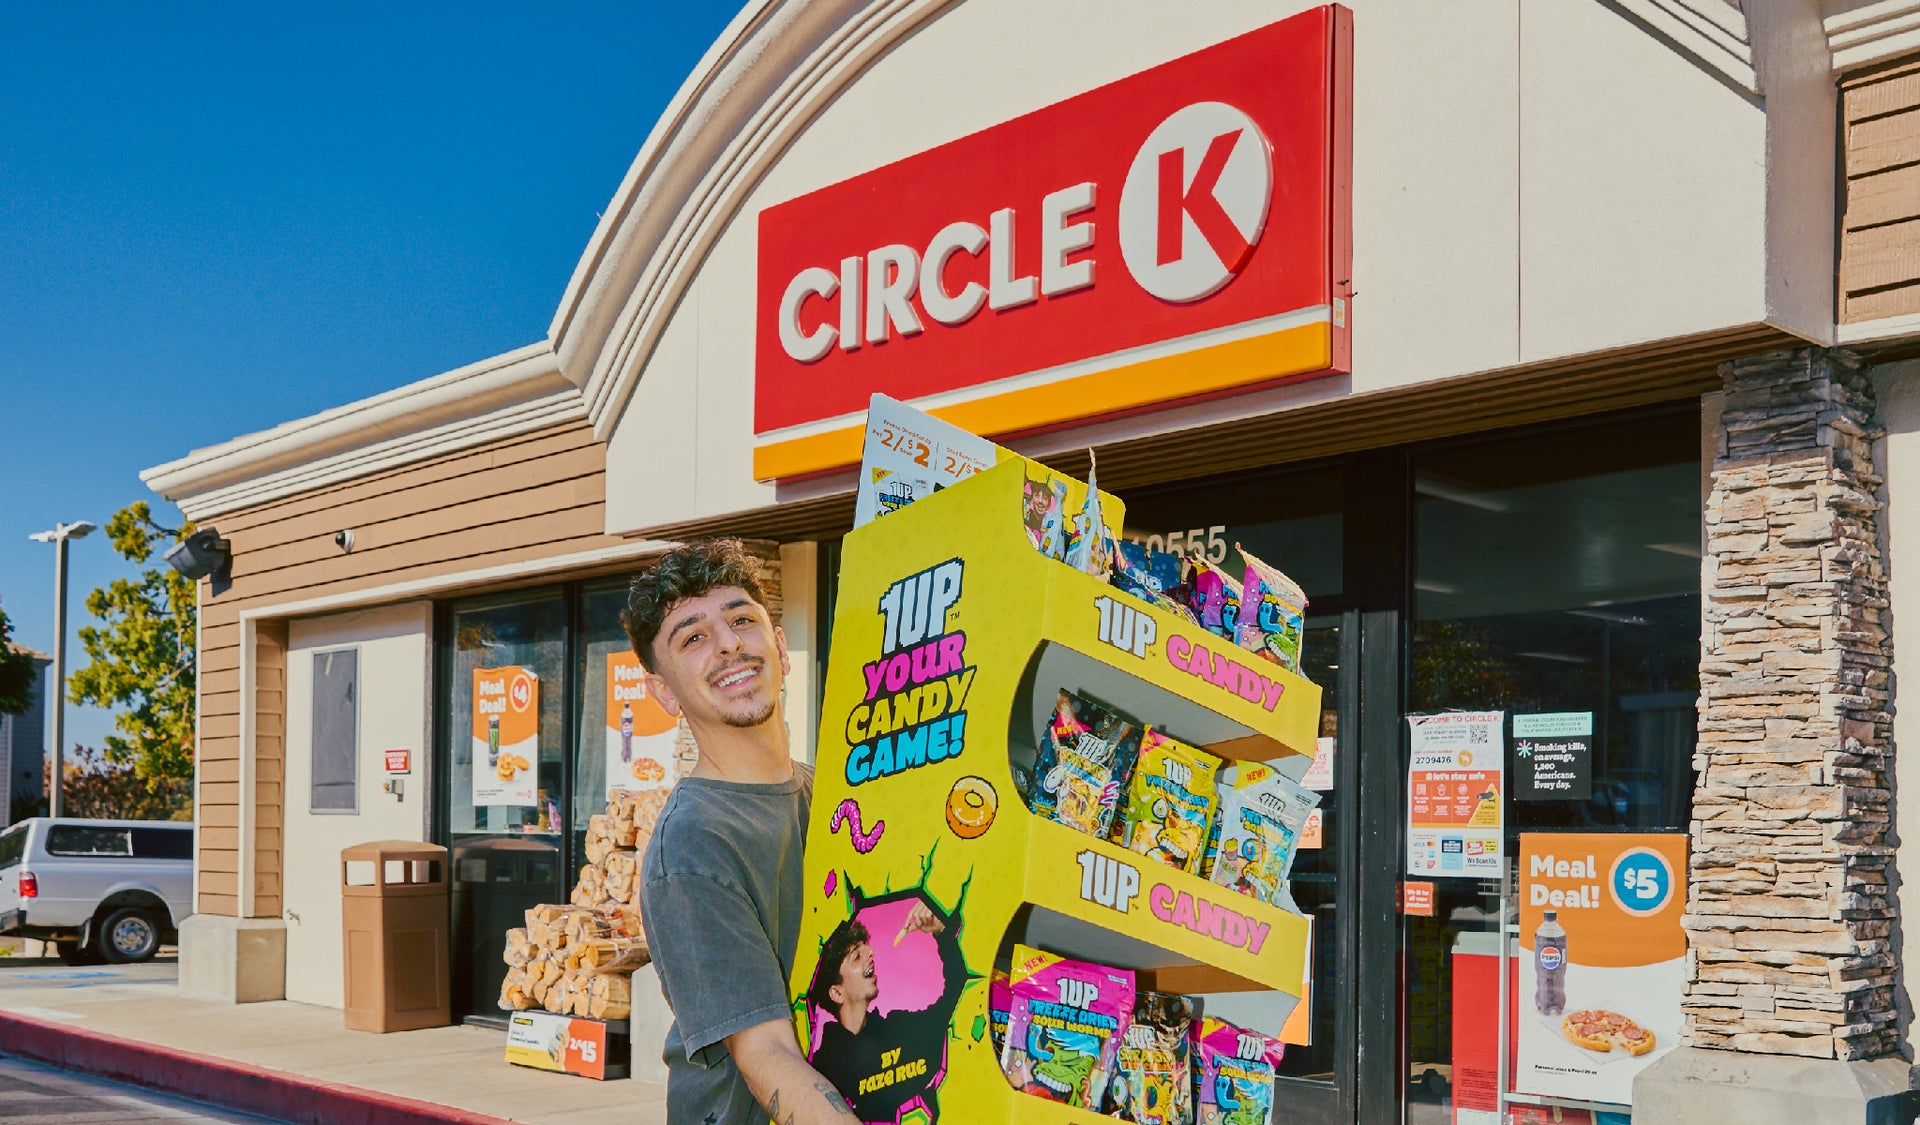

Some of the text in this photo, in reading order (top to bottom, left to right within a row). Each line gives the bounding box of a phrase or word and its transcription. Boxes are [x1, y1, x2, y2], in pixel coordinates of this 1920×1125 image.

[778, 128, 1254, 363] CIRCLE K
[1131, 525, 1227, 565] 0555
[879, 557, 964, 655] 1UP
[1095, 594, 1157, 660] 1UP
[1166, 634, 1284, 712] CANDY
[614, 664, 644, 682] Meal
[864, 632, 966, 701] YOUR
[479, 678, 505, 696] Meal
[513, 685, 528, 703] $4
[614, 683, 647, 701] Deal!
[479, 697, 507, 714] Deal!
[846, 665, 977, 745] CANDY
[1453, 715, 1463, 723] TO
[1465, 714, 1492, 722] CIRCLE
[846, 712, 967, 785] GAME!
[1534, 742, 1587, 753] Smoking kills,
[1162, 757, 1193, 789] 1UP
[1246, 766, 1266, 781] NEW!
[1534, 770, 1577, 780] Americans.
[1534, 780, 1571, 790] Every day.
[1530, 854, 1597, 879] Meal
[1624, 867, 1659, 899] $5
[1076, 848, 1141, 914] 1UP
[1150, 883, 1271, 955] CANDY
[1530, 884, 1600, 908] Deal!
[1024, 954, 1048, 971] NEW!
[1057, 977, 1099, 1011] 1UP
[1028, 998, 1078, 1023] FREEZE
[1079, 1010, 1118, 1031] DRIED
[1032, 1014, 1112, 1039] SOUR WORMS
[881, 1047, 901, 1069] BY
[1236, 1033, 1266, 1061] 1UP
[896, 1059, 927, 1083] RUG
